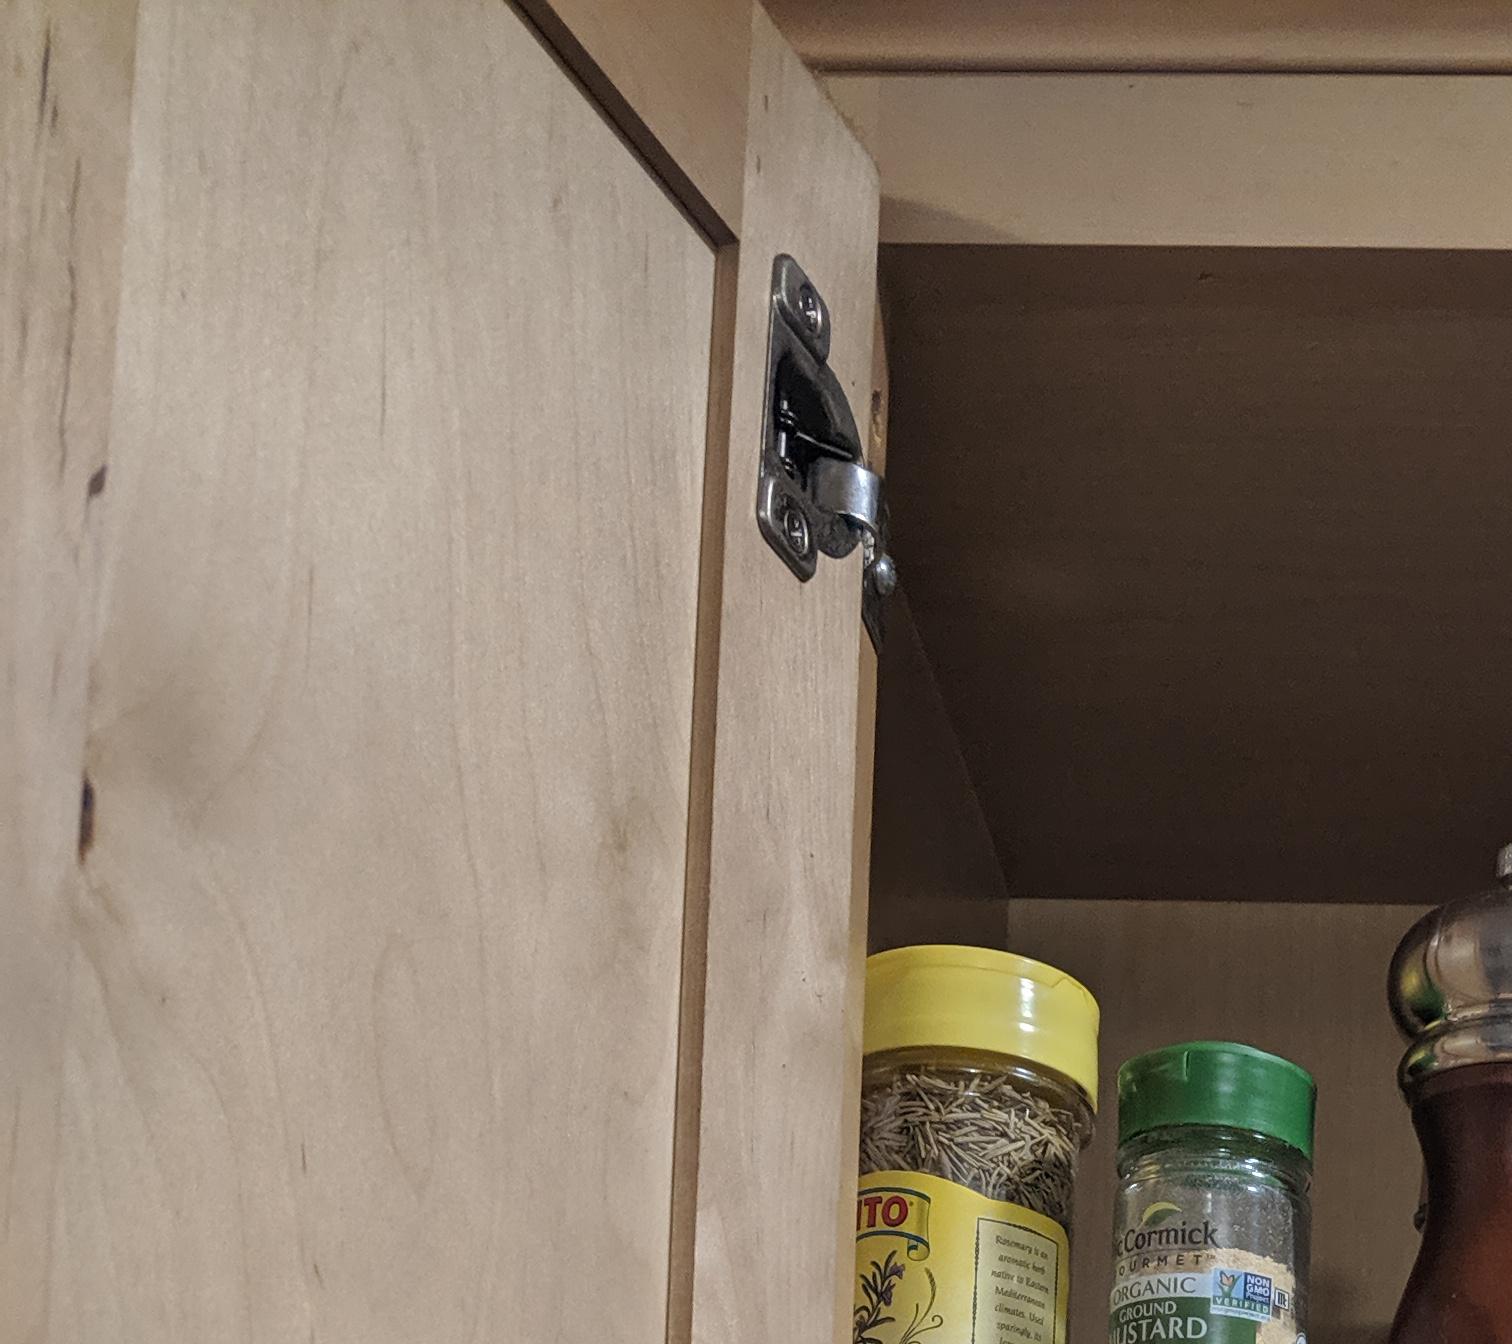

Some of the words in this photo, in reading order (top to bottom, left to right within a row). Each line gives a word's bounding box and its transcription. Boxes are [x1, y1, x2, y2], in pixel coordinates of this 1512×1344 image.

[1118, 1254, 1202, 1277] OURMET
[1246, 1274, 1270, 1288] NON
[1246, 1283, 1270, 1297] GMO
[1113, 1277, 1197, 1306] ORGANIC
[1120, 1301, 1177, 1323] GROUND
[1215, 1297, 1269, 1314] VERIFIED
